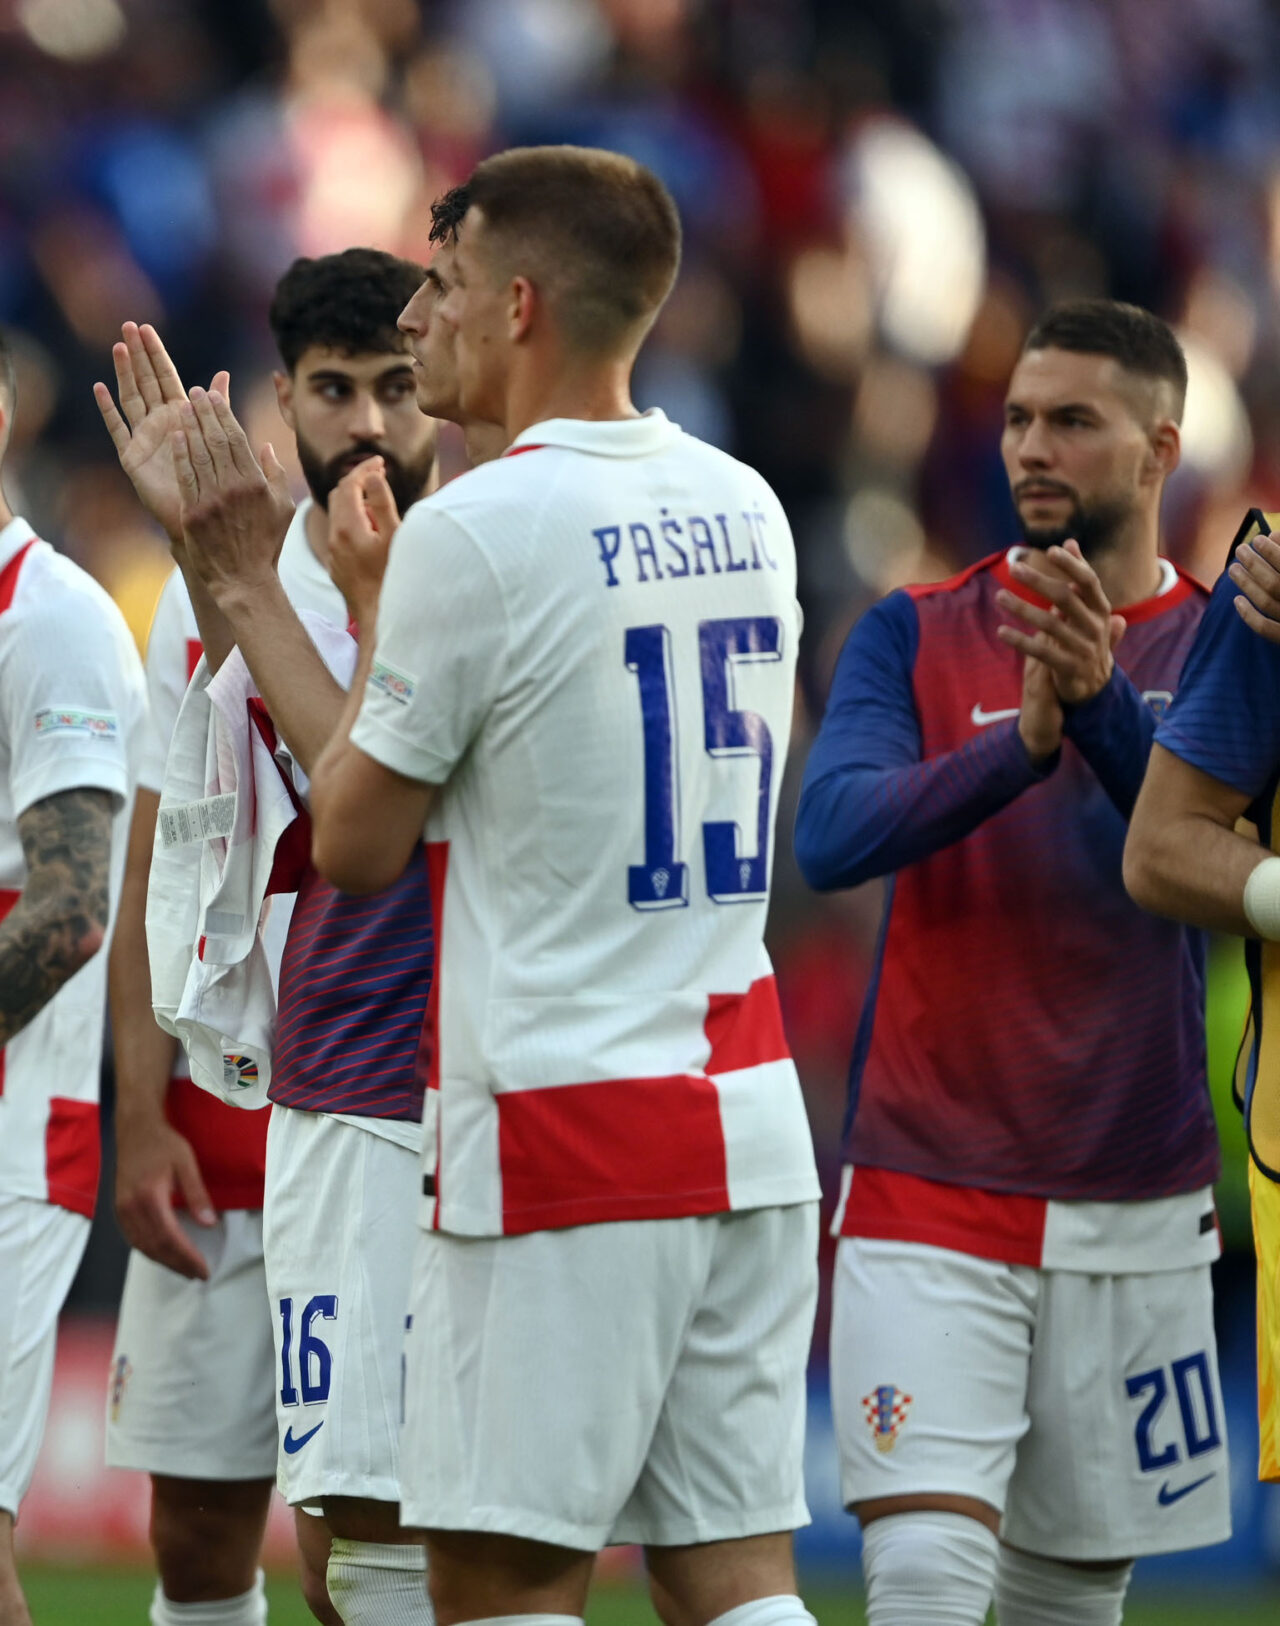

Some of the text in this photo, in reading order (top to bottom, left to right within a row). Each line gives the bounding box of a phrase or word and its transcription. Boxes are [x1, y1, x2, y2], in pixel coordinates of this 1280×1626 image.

[624, 616, 784, 912] 15
[279, 1294, 339, 1408] 16
[1124, 1349, 1222, 1473] 20
